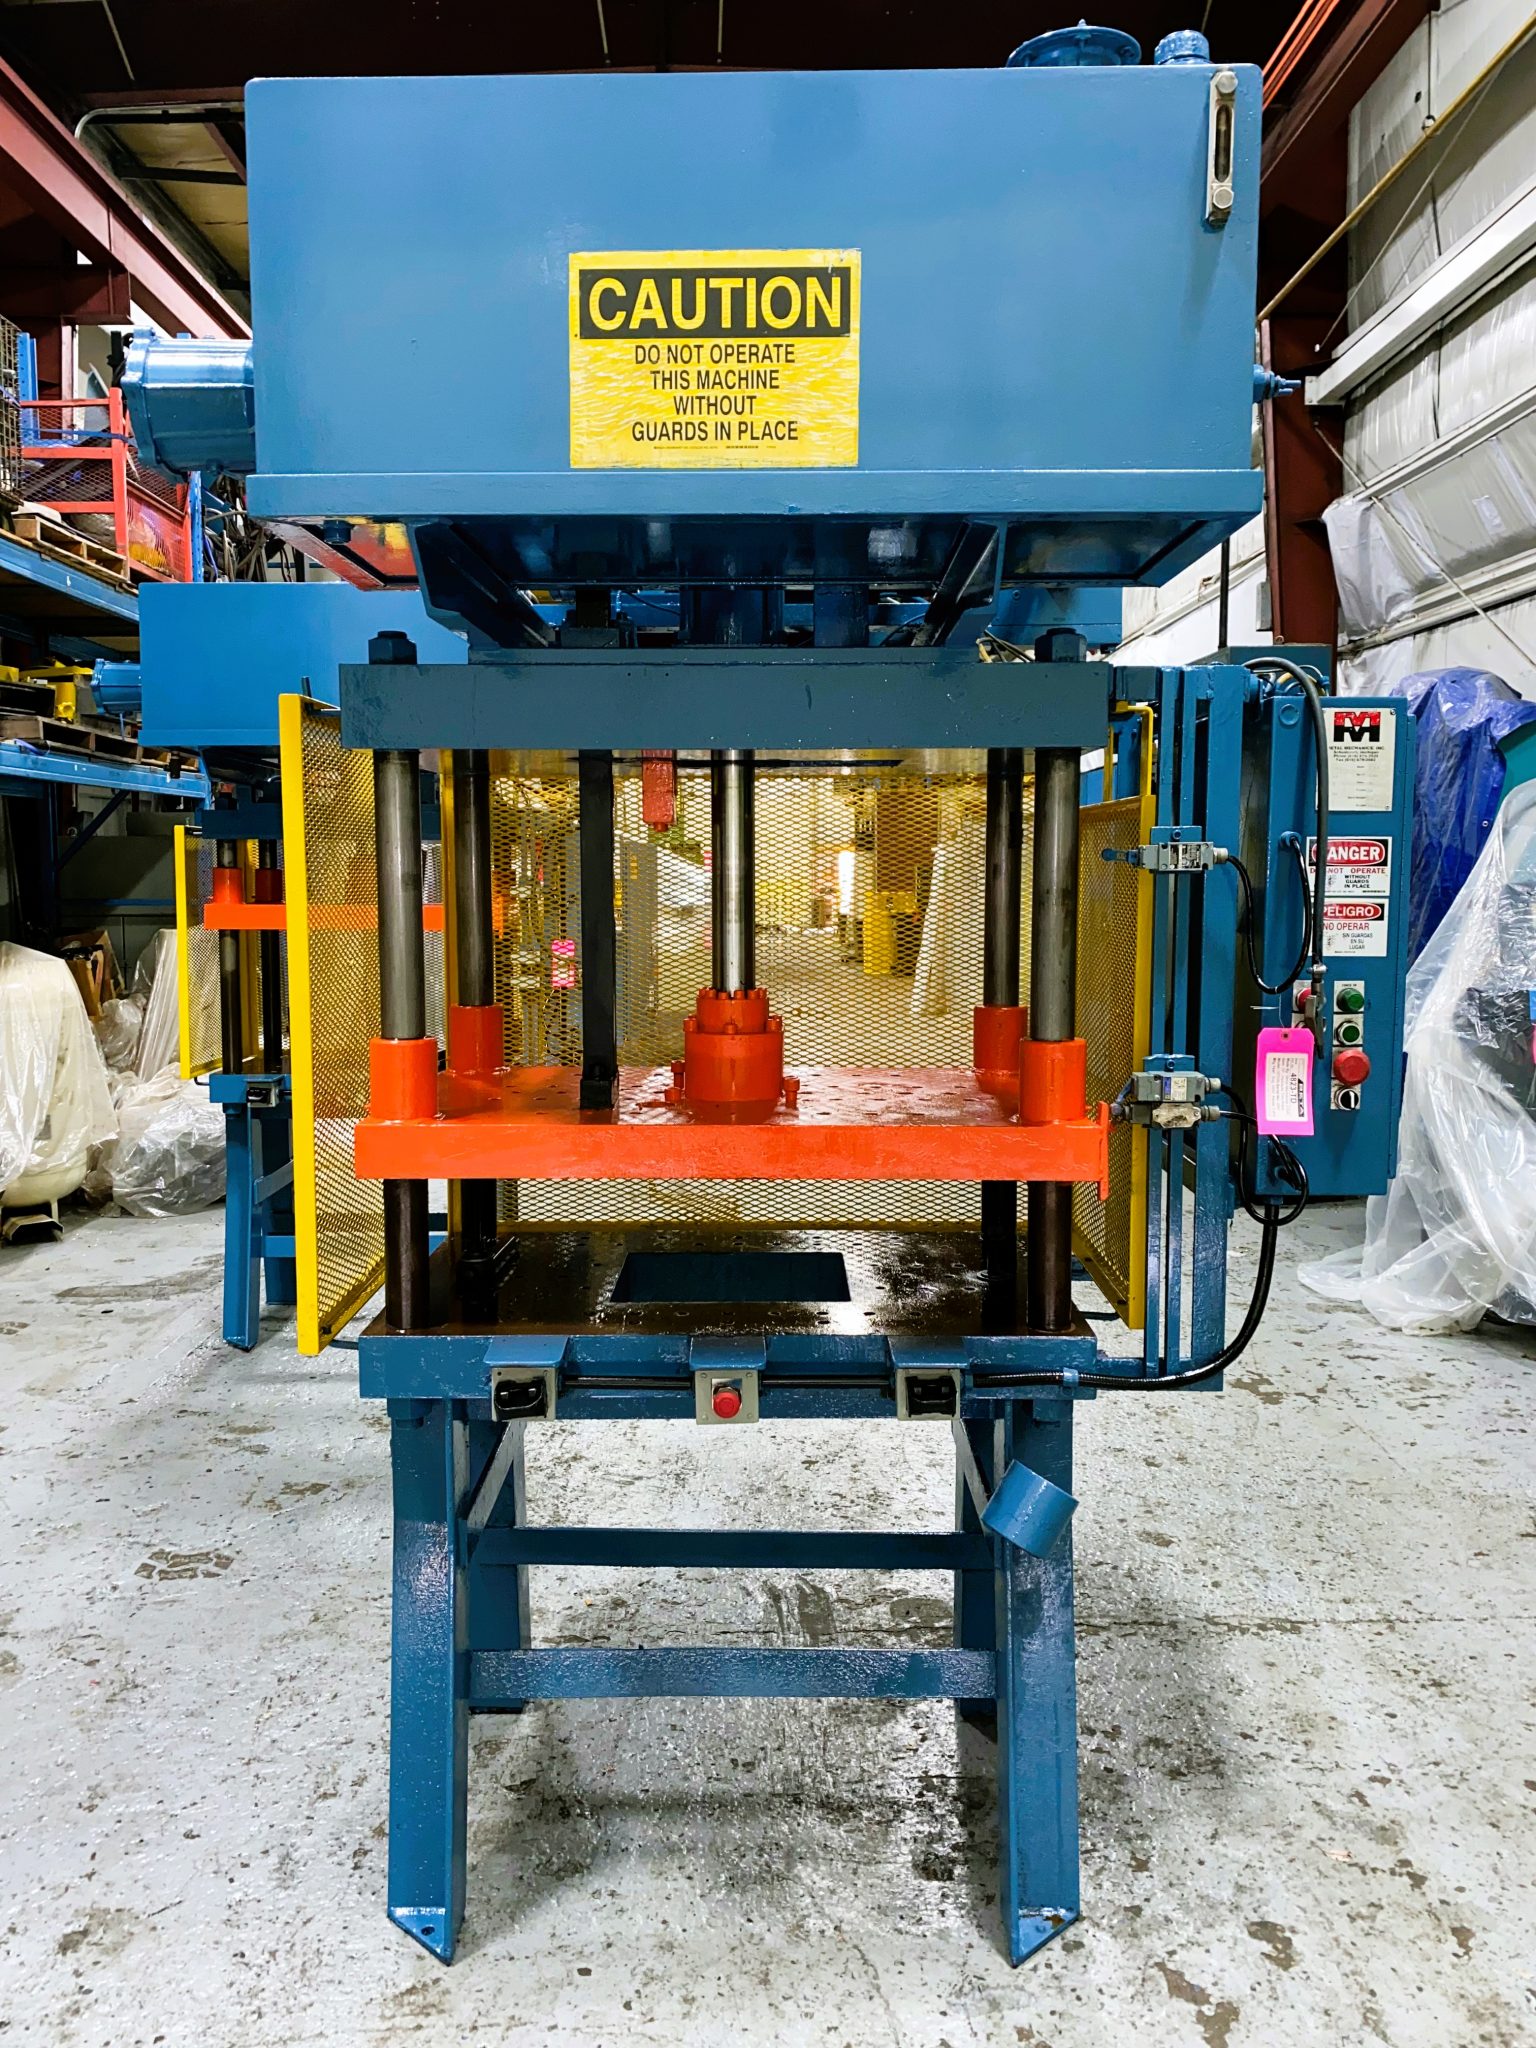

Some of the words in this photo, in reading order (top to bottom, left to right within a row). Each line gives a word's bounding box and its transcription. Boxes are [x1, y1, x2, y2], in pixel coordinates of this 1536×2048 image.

[589, 276, 841, 330] CAUTION
[635, 344, 660, 364] DO
[667, 344, 704, 364] NOT
[710, 344, 795, 363] OPERATE
[650, 370, 690, 390] THIS
[697, 369, 780, 389] MACHINE
[673, 395, 757, 415] WITHOUT
[632, 421, 708, 441] GUARDS
[715, 421, 731, 440] IN
[738, 421, 798, 440] PLACE
[1327, 846, 1380, 860] ANGER
[1323, 922, 1334, 931] NO
[1337, 922, 1370, 931] OPERAR
